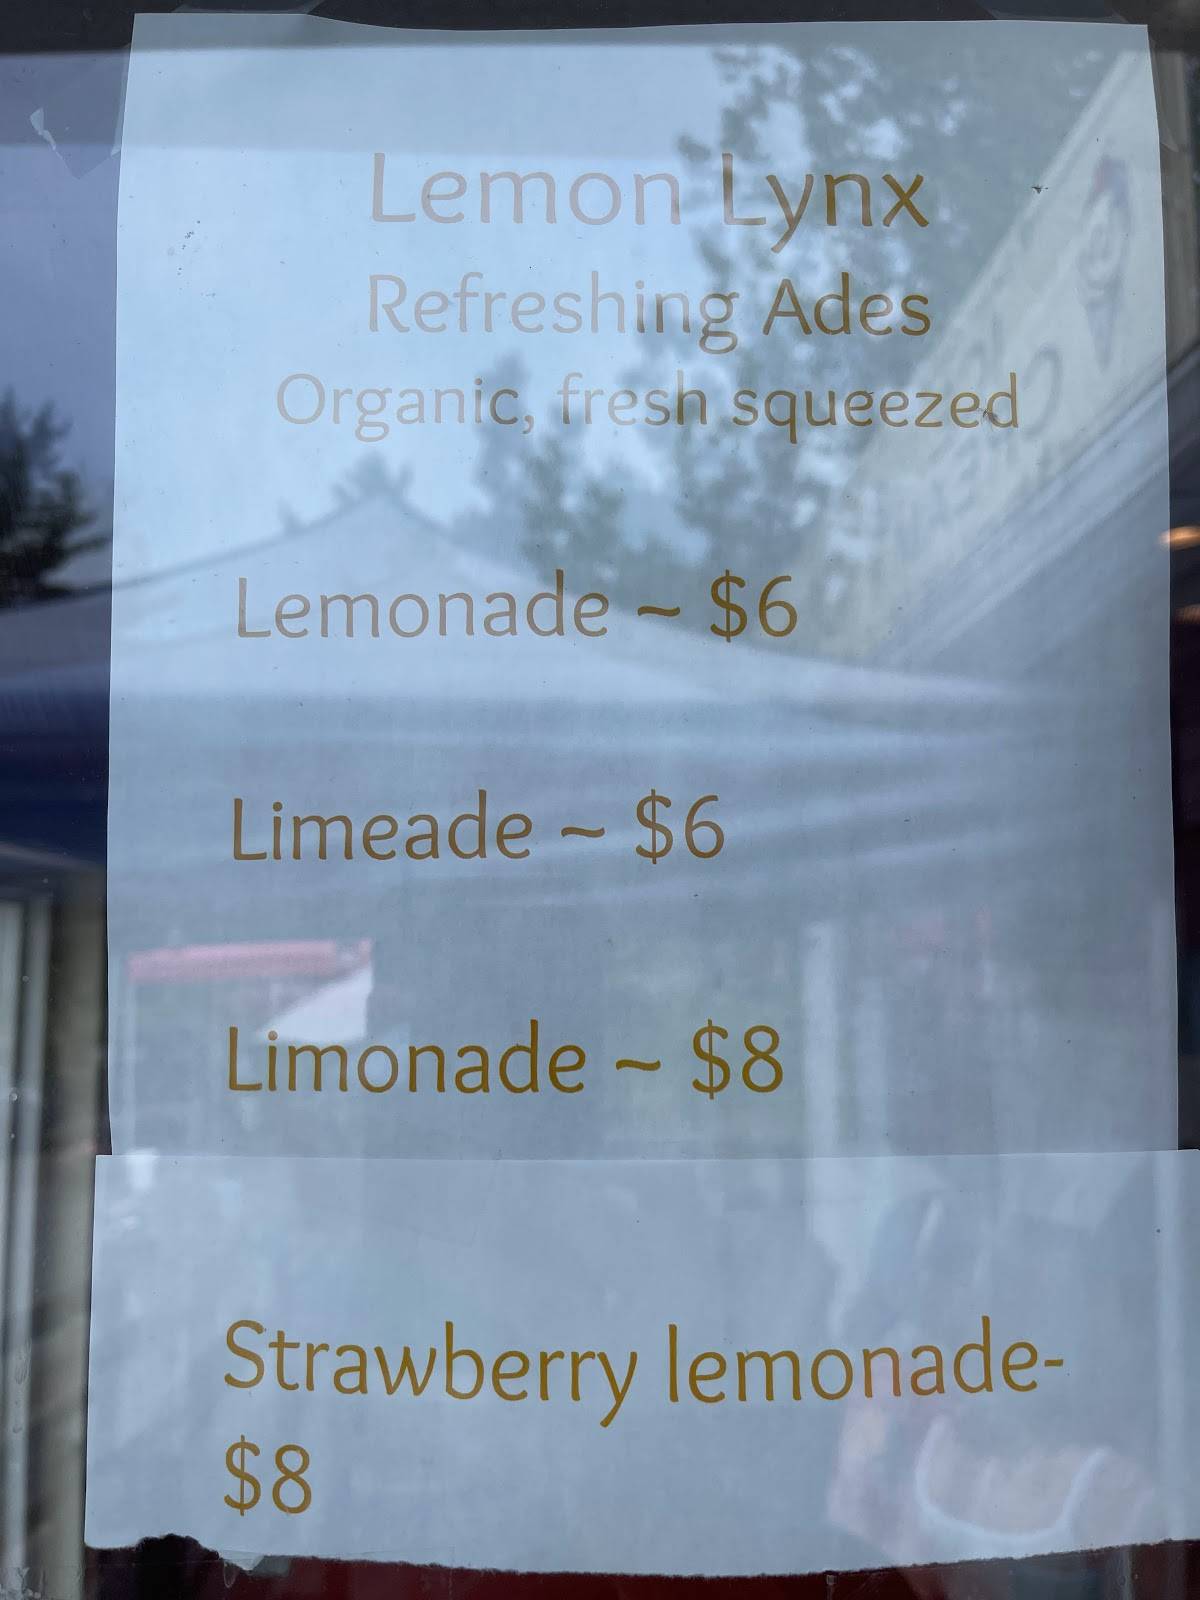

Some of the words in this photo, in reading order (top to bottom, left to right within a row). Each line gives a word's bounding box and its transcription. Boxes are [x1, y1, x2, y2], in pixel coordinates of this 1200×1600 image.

[371, 152, 682, 226] Lemon
[721, 152, 930, 253] Lynx
[366, 270, 740, 356] Refreshing
[760, 270, 934, 338] Ades
[274, 370, 537, 445] Organic,
[558, 370, 707, 427] fresh
[730, 370, 1022, 445] squeezed
[237, 568, 611, 638] Lemonade
[708, 568, 800, 643] $6
[232, 788, 533, 860] Limeade
[634, 788, 726, 866] $6
[227, 1018, 587, 1096] Limonade
[691, 1018, 784, 1100] $8
[223, 1318, 638, 1428] Strawberry
[667, 1315, 1064, 1404] lemonade-
[223, 1434, 313, 1517] $8
